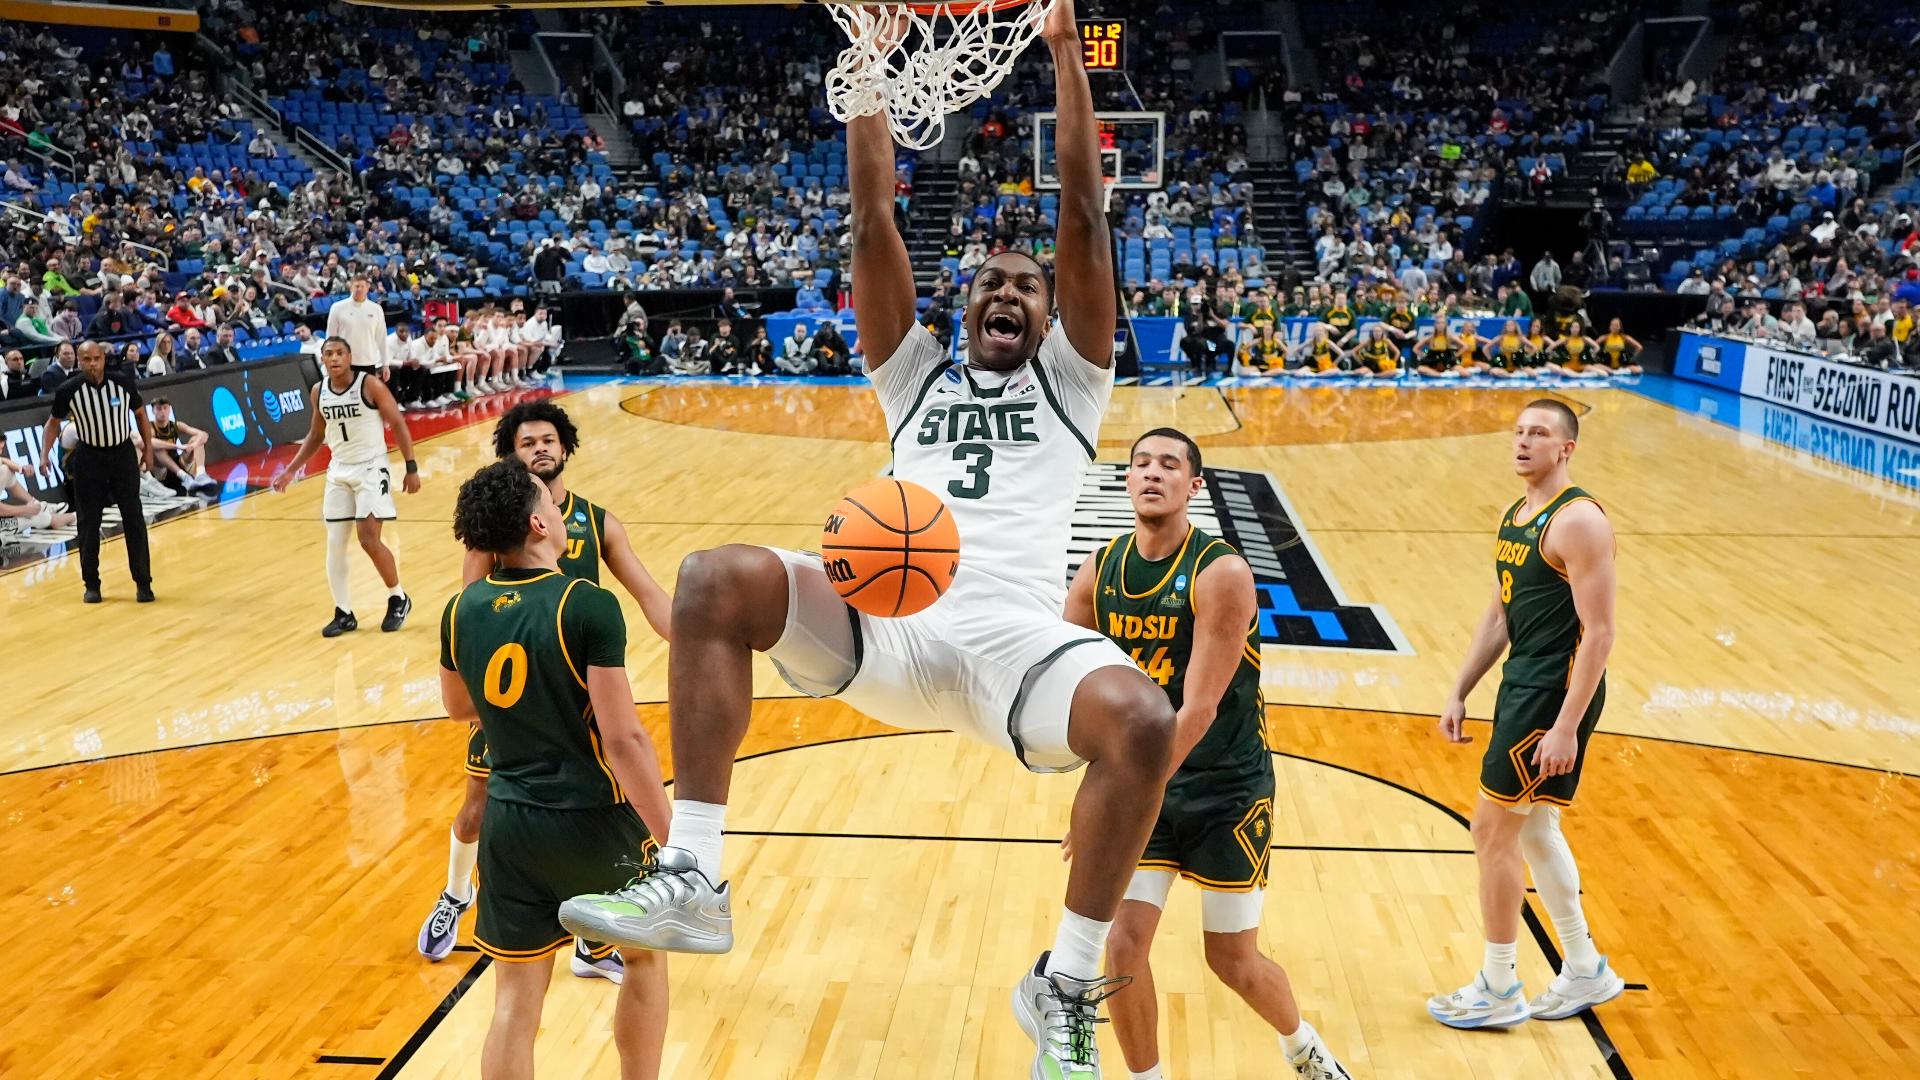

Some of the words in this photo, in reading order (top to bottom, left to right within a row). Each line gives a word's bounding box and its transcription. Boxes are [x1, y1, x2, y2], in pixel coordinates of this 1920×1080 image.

[1084, 24, 1122, 39] 11:12
[1084, 40, 1117, 67] 30
[279, 389, 304, 414] AT&T
[1766, 356, 1805, 404] FIRST
[1813, 367, 1882, 424] SECOND
[220, 413, 246, 433] NCAA
[322, 403, 362, 420] STATE
[916, 402, 1040, 446] STATE
[338, 422, 349, 442] 1
[947, 442, 993, 499] 3
[1501, 569, 1514, 604] 8
[1108, 611, 1179, 640] NDSU
[484, 642, 528, 709] 0
